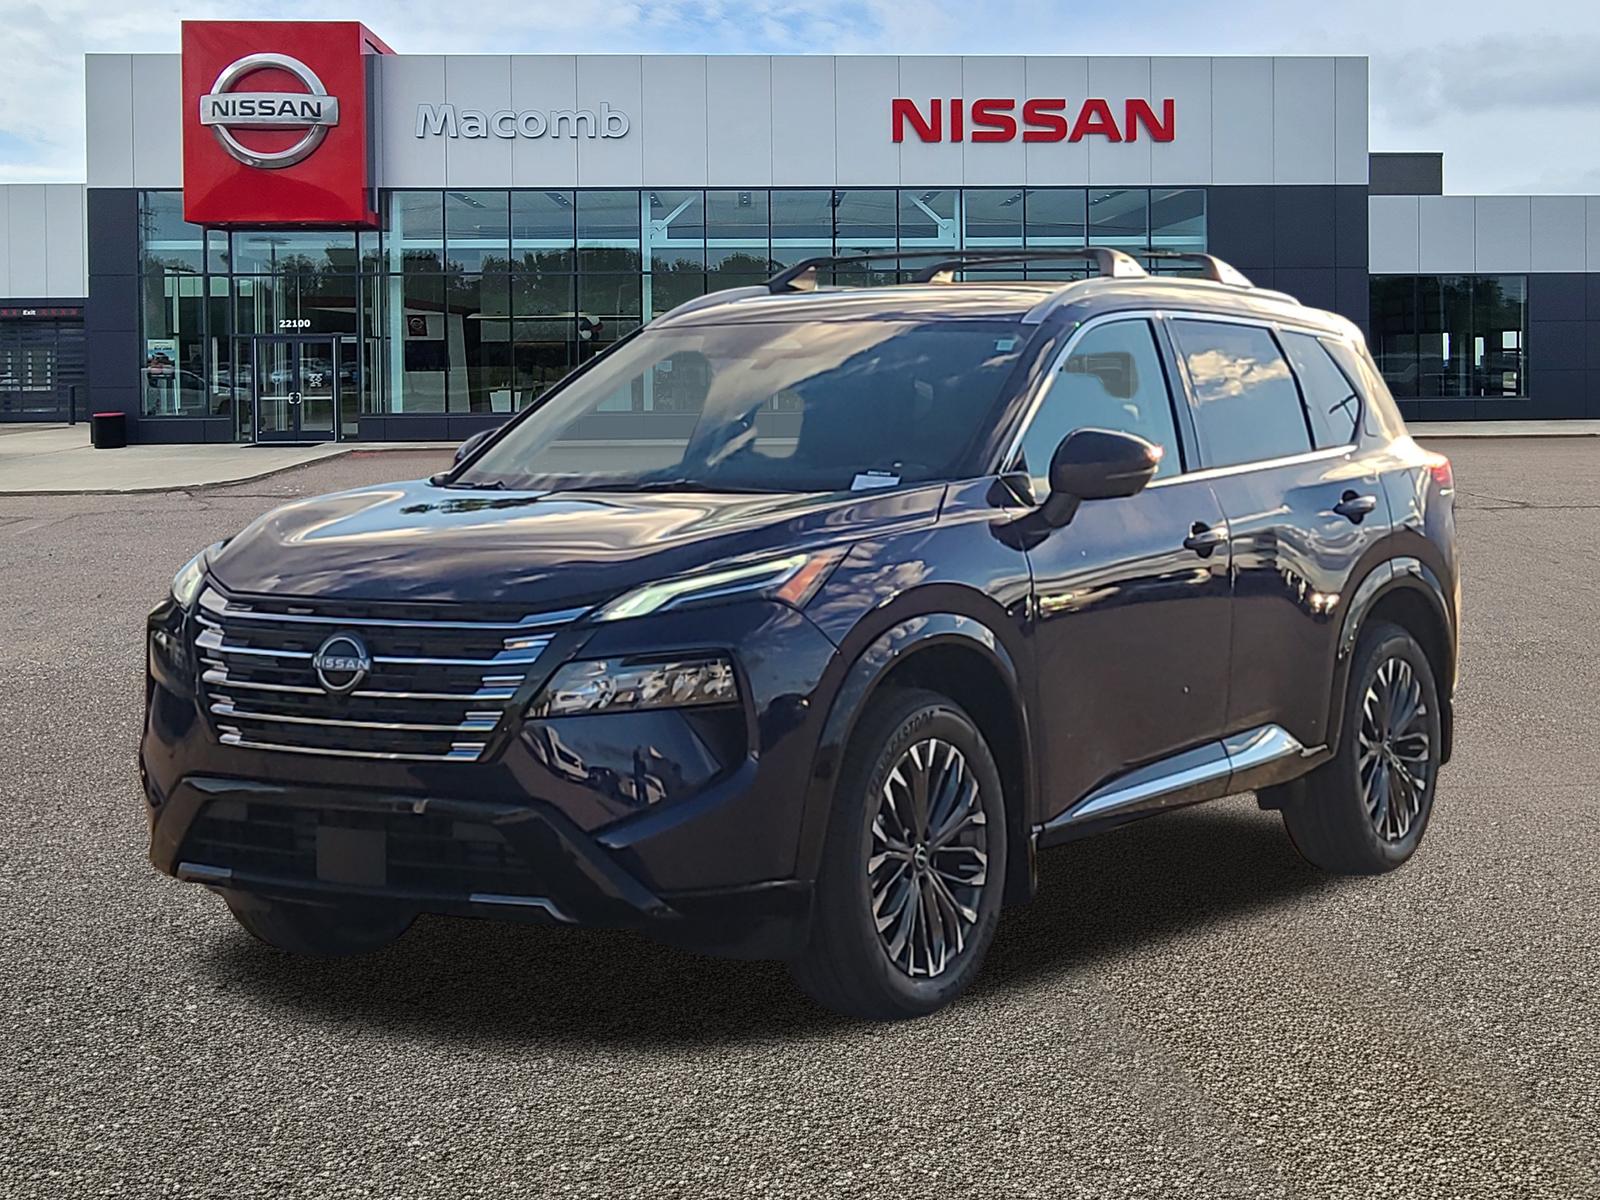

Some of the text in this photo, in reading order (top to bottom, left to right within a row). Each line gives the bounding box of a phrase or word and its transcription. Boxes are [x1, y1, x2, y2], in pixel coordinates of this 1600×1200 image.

[211, 100, 322, 118] NISSAN
[415, 102, 630, 138] Macomb
[892, 98, 1175, 142] NISSAN
[279, 319, 311, 328] 22100
[312, 656, 370, 670] NISSAN
